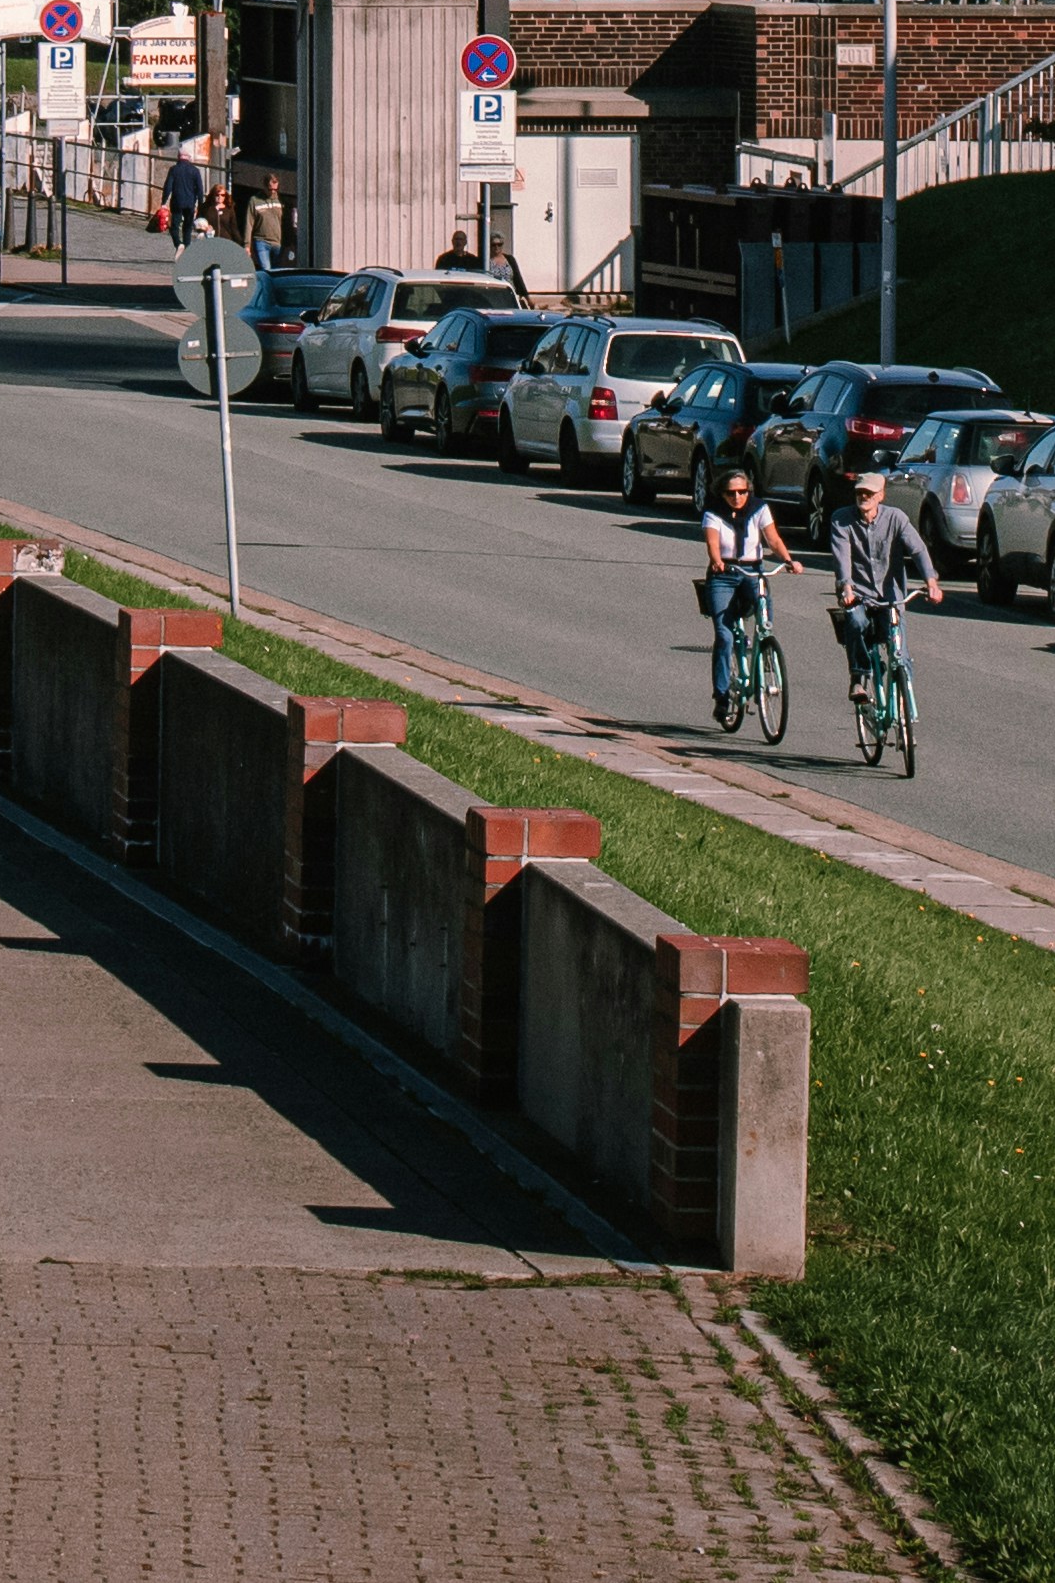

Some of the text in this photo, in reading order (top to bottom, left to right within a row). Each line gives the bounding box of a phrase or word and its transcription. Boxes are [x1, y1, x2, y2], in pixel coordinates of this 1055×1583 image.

[133, 39, 148, 47] DIE
[150, 39, 167, 47] JAN
[170, 39, 187, 47] CUX
[54, 47, 71, 69] P
[132, 72, 152, 80] NUR
[478, 95, 499, 121] P
